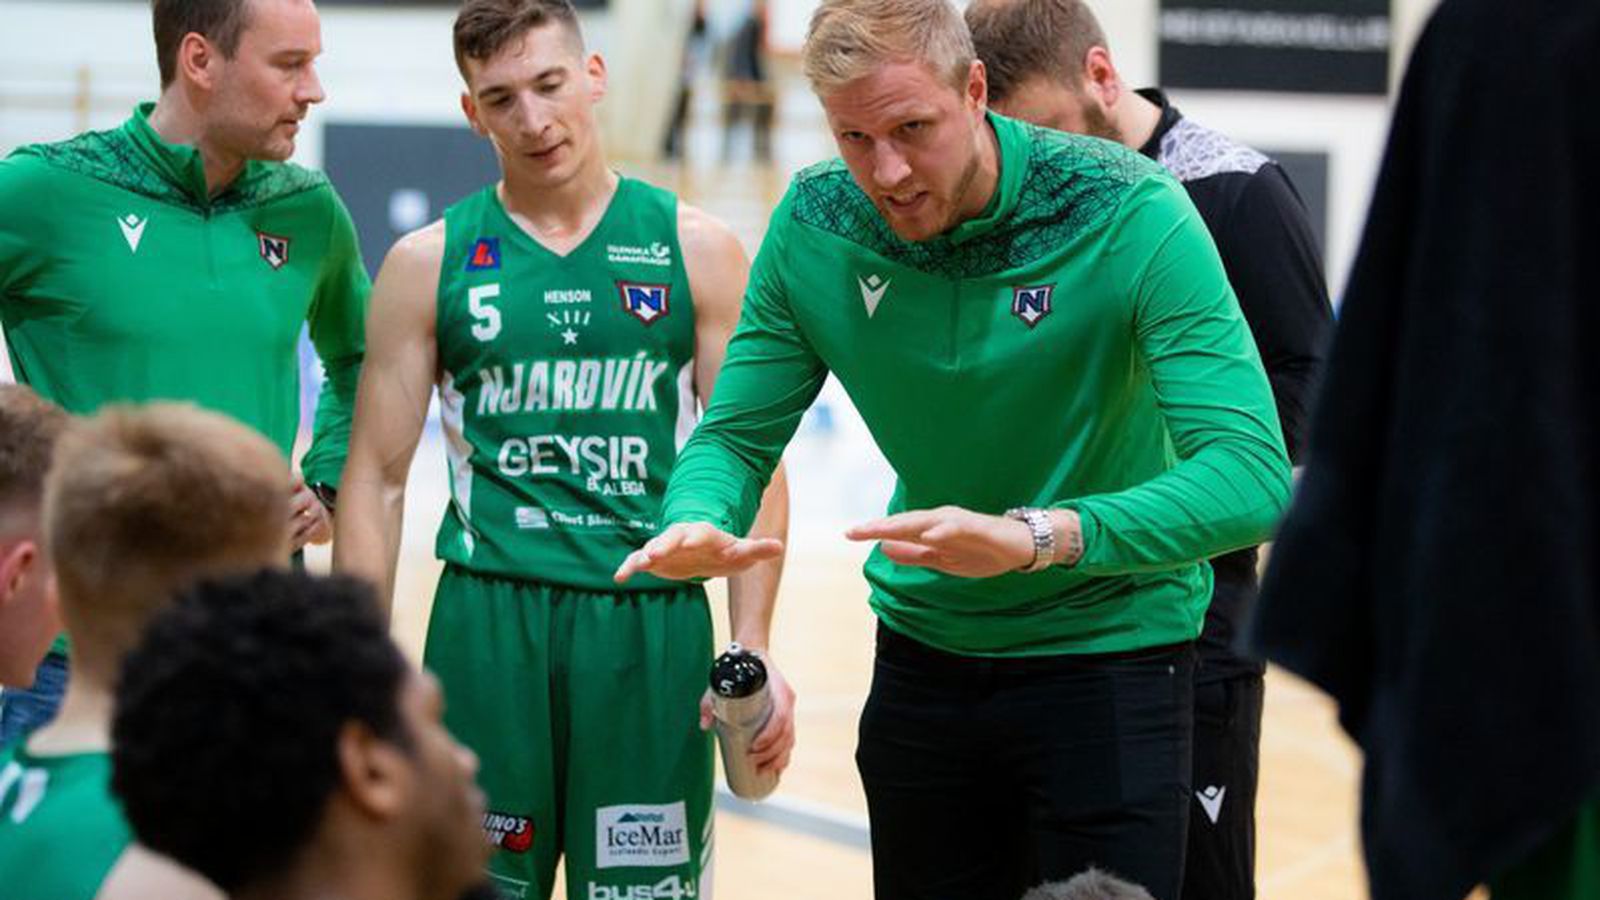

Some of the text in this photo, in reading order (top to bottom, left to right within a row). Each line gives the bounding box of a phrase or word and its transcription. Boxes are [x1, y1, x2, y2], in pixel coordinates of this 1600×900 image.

[468, 283, 502, 341] 5
[543, 289, 592, 304] HENSON
[498, 434, 649, 480] GEYSIR
[607, 825, 683, 848] IceMar
